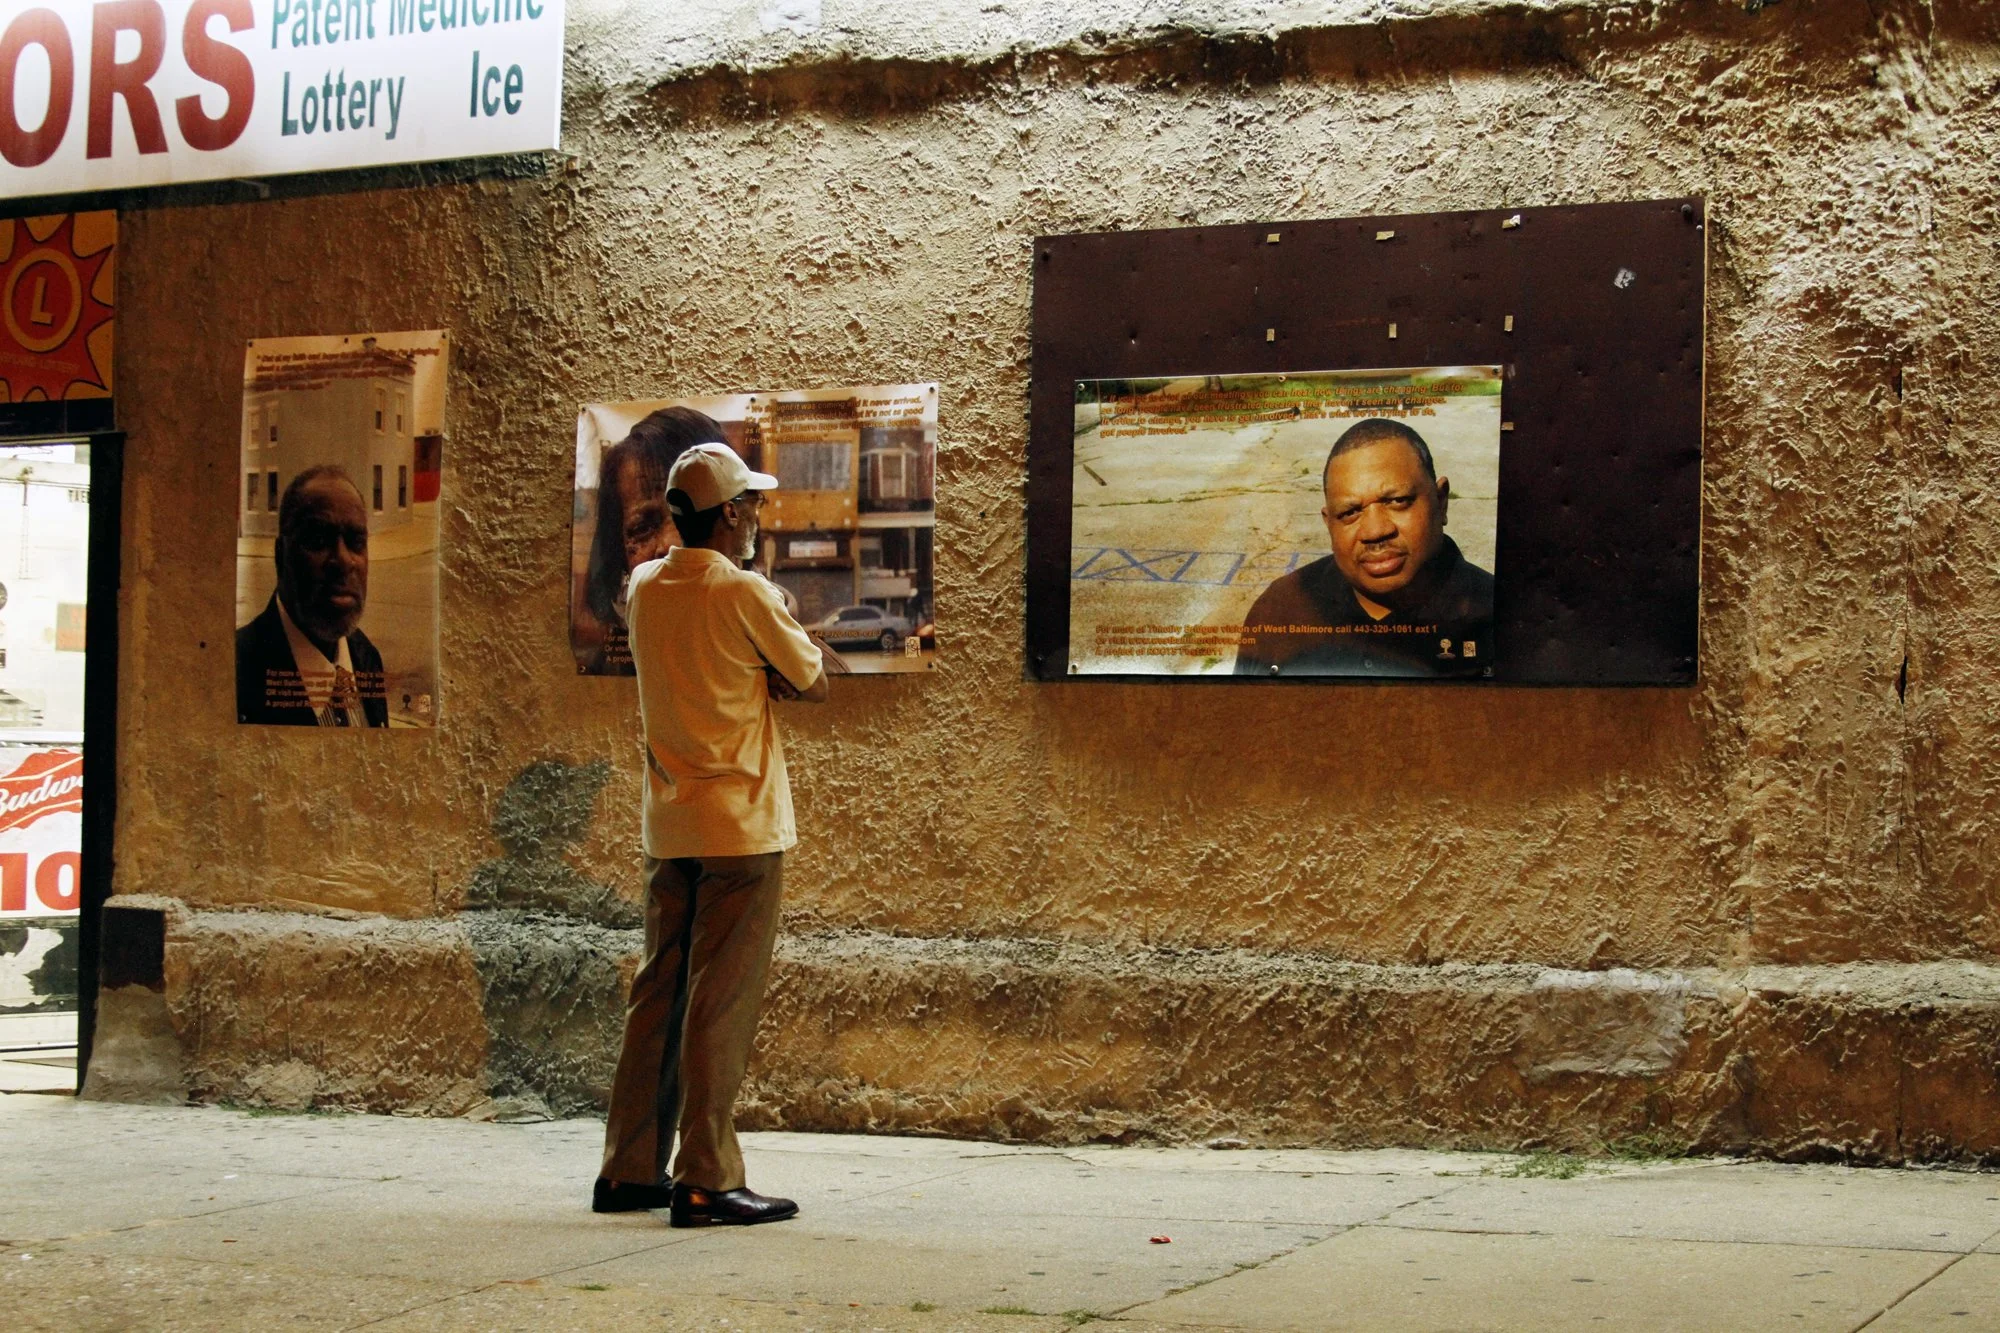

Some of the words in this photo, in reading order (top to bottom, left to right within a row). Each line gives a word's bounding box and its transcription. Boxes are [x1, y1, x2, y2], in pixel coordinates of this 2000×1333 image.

[271, 0, 376, 49] Patent
[280, 69, 405, 140] Lottery
[470, 50, 524, 118] Ice
[1252, 624, 1262, 633] of
[1263, 624, 1287, 633] West
[1289, 624, 1333, 633] Baltimore
[1335, 624, 1352, 633] call
[1354, 624, 1412, 633] 443-320-1061
[1415, 624, 1430, 633] ext
